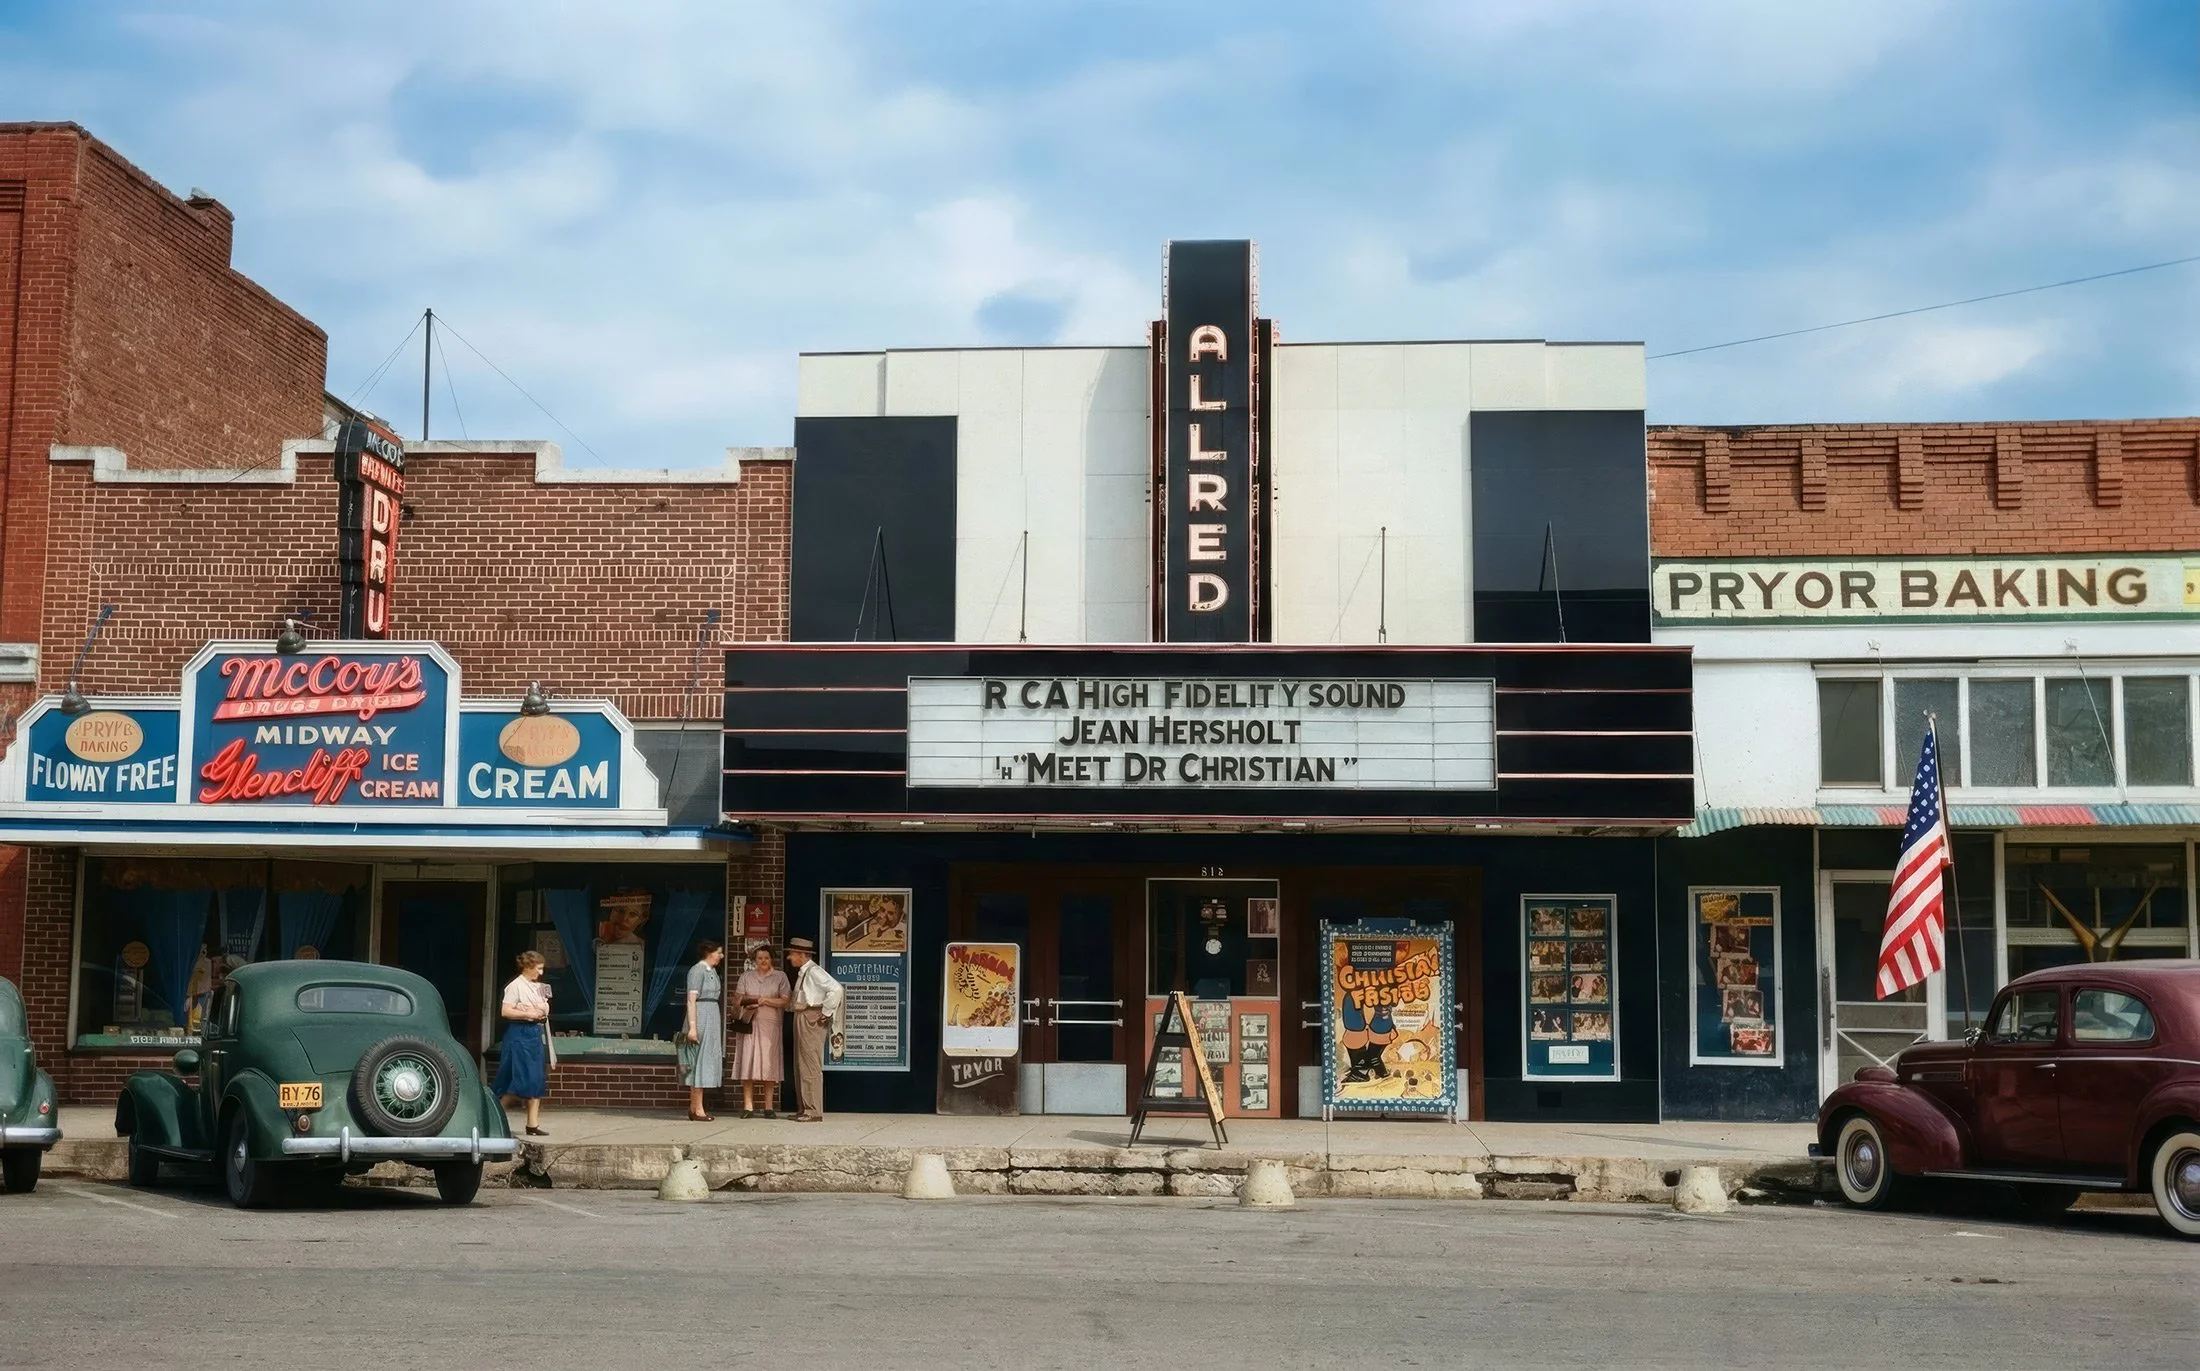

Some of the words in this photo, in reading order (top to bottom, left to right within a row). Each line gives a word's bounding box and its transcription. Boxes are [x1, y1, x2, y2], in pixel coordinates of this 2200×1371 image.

[1188, 324, 1230, 613] ALLRED
[1669, 571, 1878, 610] PRYOR
[1900, 567, 2147, 607] BAKING
[1078, 681, 1149, 709] HIGH
[1308, 684, 1406, 709] SOUND
[254, 726, 398, 745] MIDWAY
[1059, 716, 1138, 745] JEAN
[1149, 716, 1301, 744] HERSHOLT
[32, 752, 110, 792] FLOWAY
[116, 754, 176, 792] FREE
[199, 738, 371, 804] Glencliff
[382, 754, 419, 771] ICE
[1125, 753, 1166, 782] DR
[360, 781, 439, 798] CREAM
[468, 760, 609, 799] CREAM
